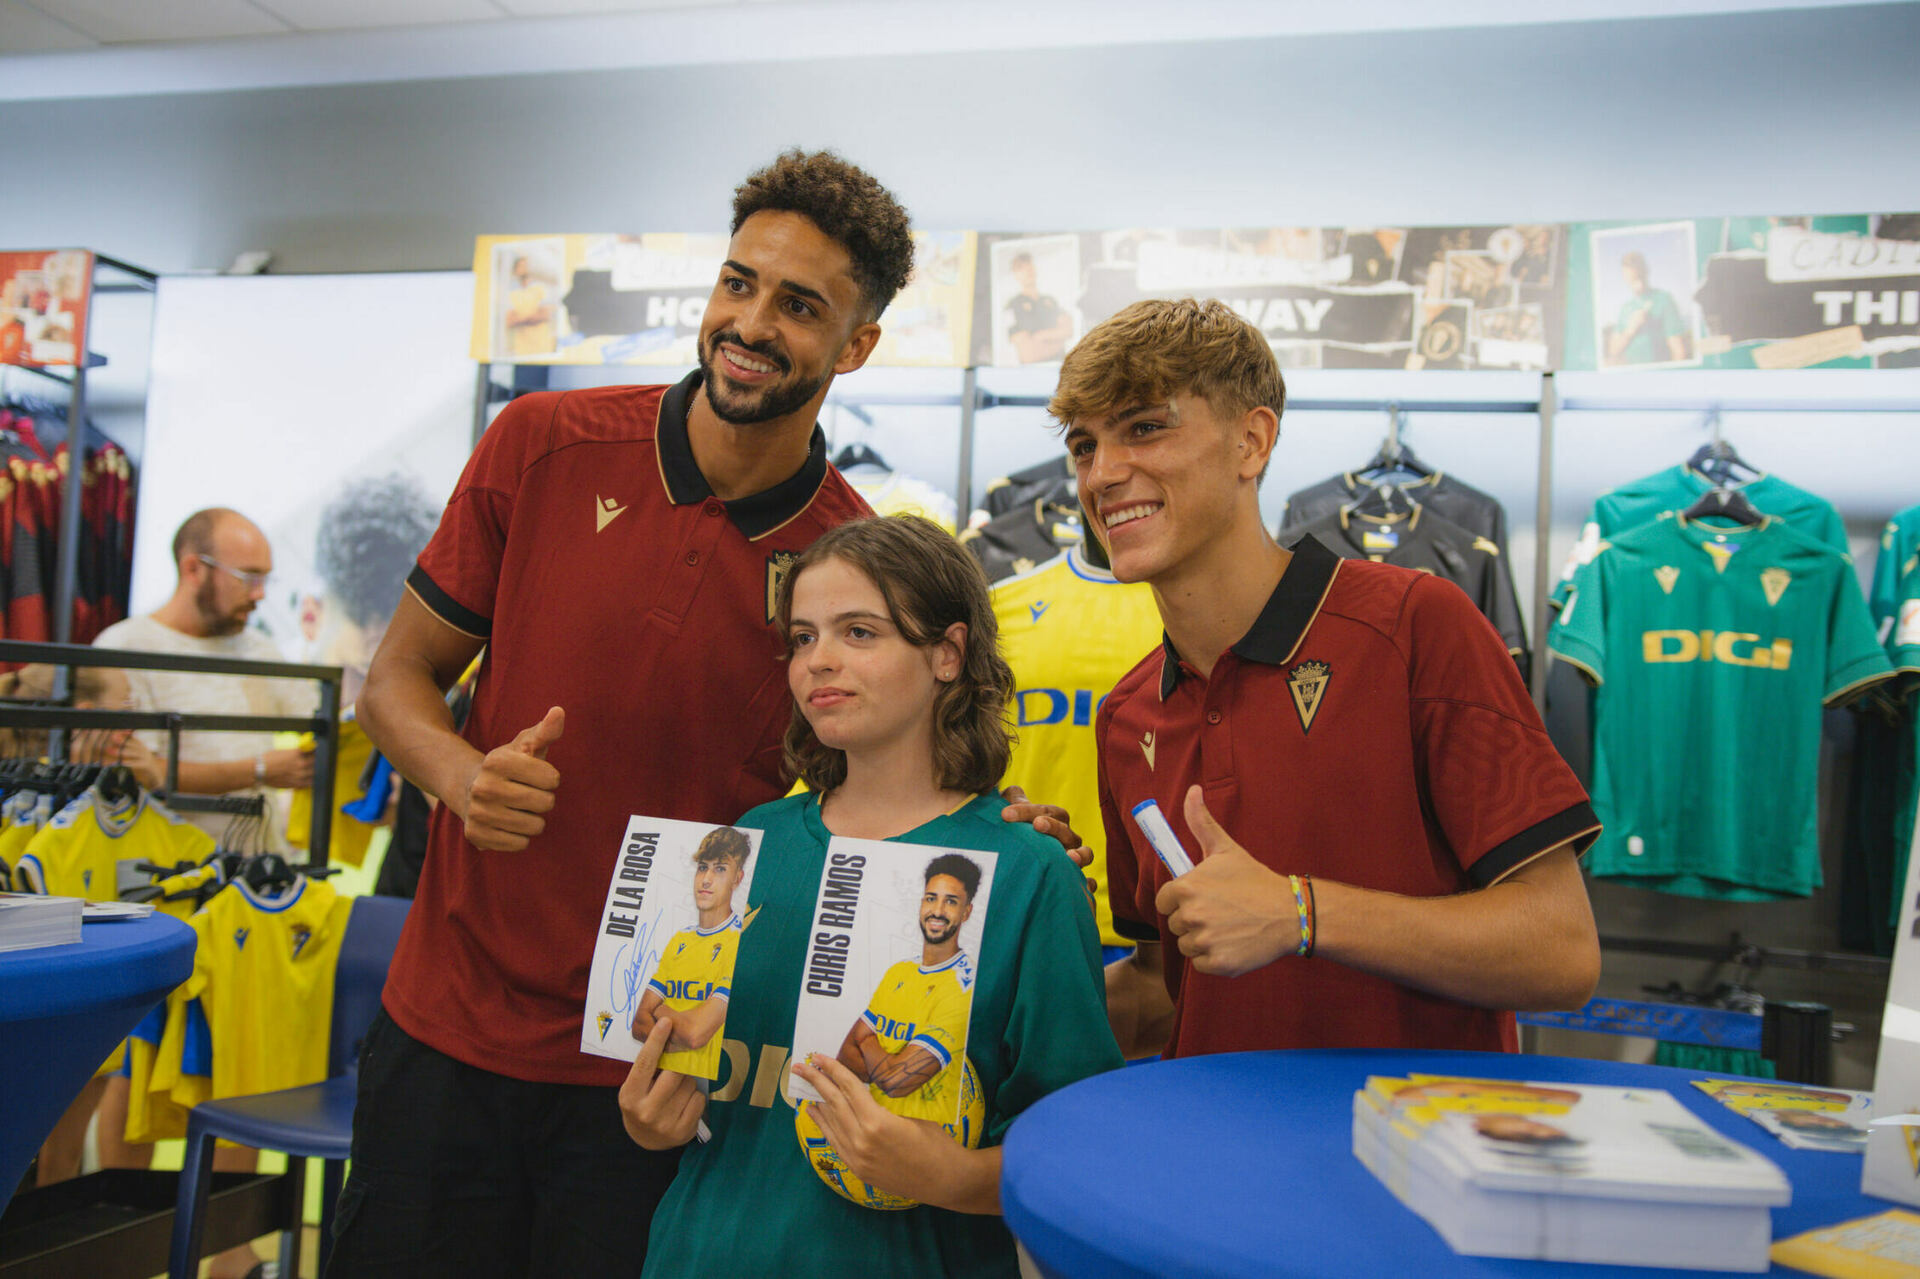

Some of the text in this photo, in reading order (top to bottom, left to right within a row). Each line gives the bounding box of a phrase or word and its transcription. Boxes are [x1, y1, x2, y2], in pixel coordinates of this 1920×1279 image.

[1791, 239, 1920, 271] CADI
[1813, 290, 1919, 326] THI
[1642, 629, 1793, 671] DIGI
[1016, 688, 1110, 727] DI
[619, 832, 661, 883] ROSA
[612, 887, 646, 911] LA
[605, 911, 639, 939] DE
[806, 853, 867, 998] CHRIS RAMOS
[709, 1038, 796, 1110] DI
